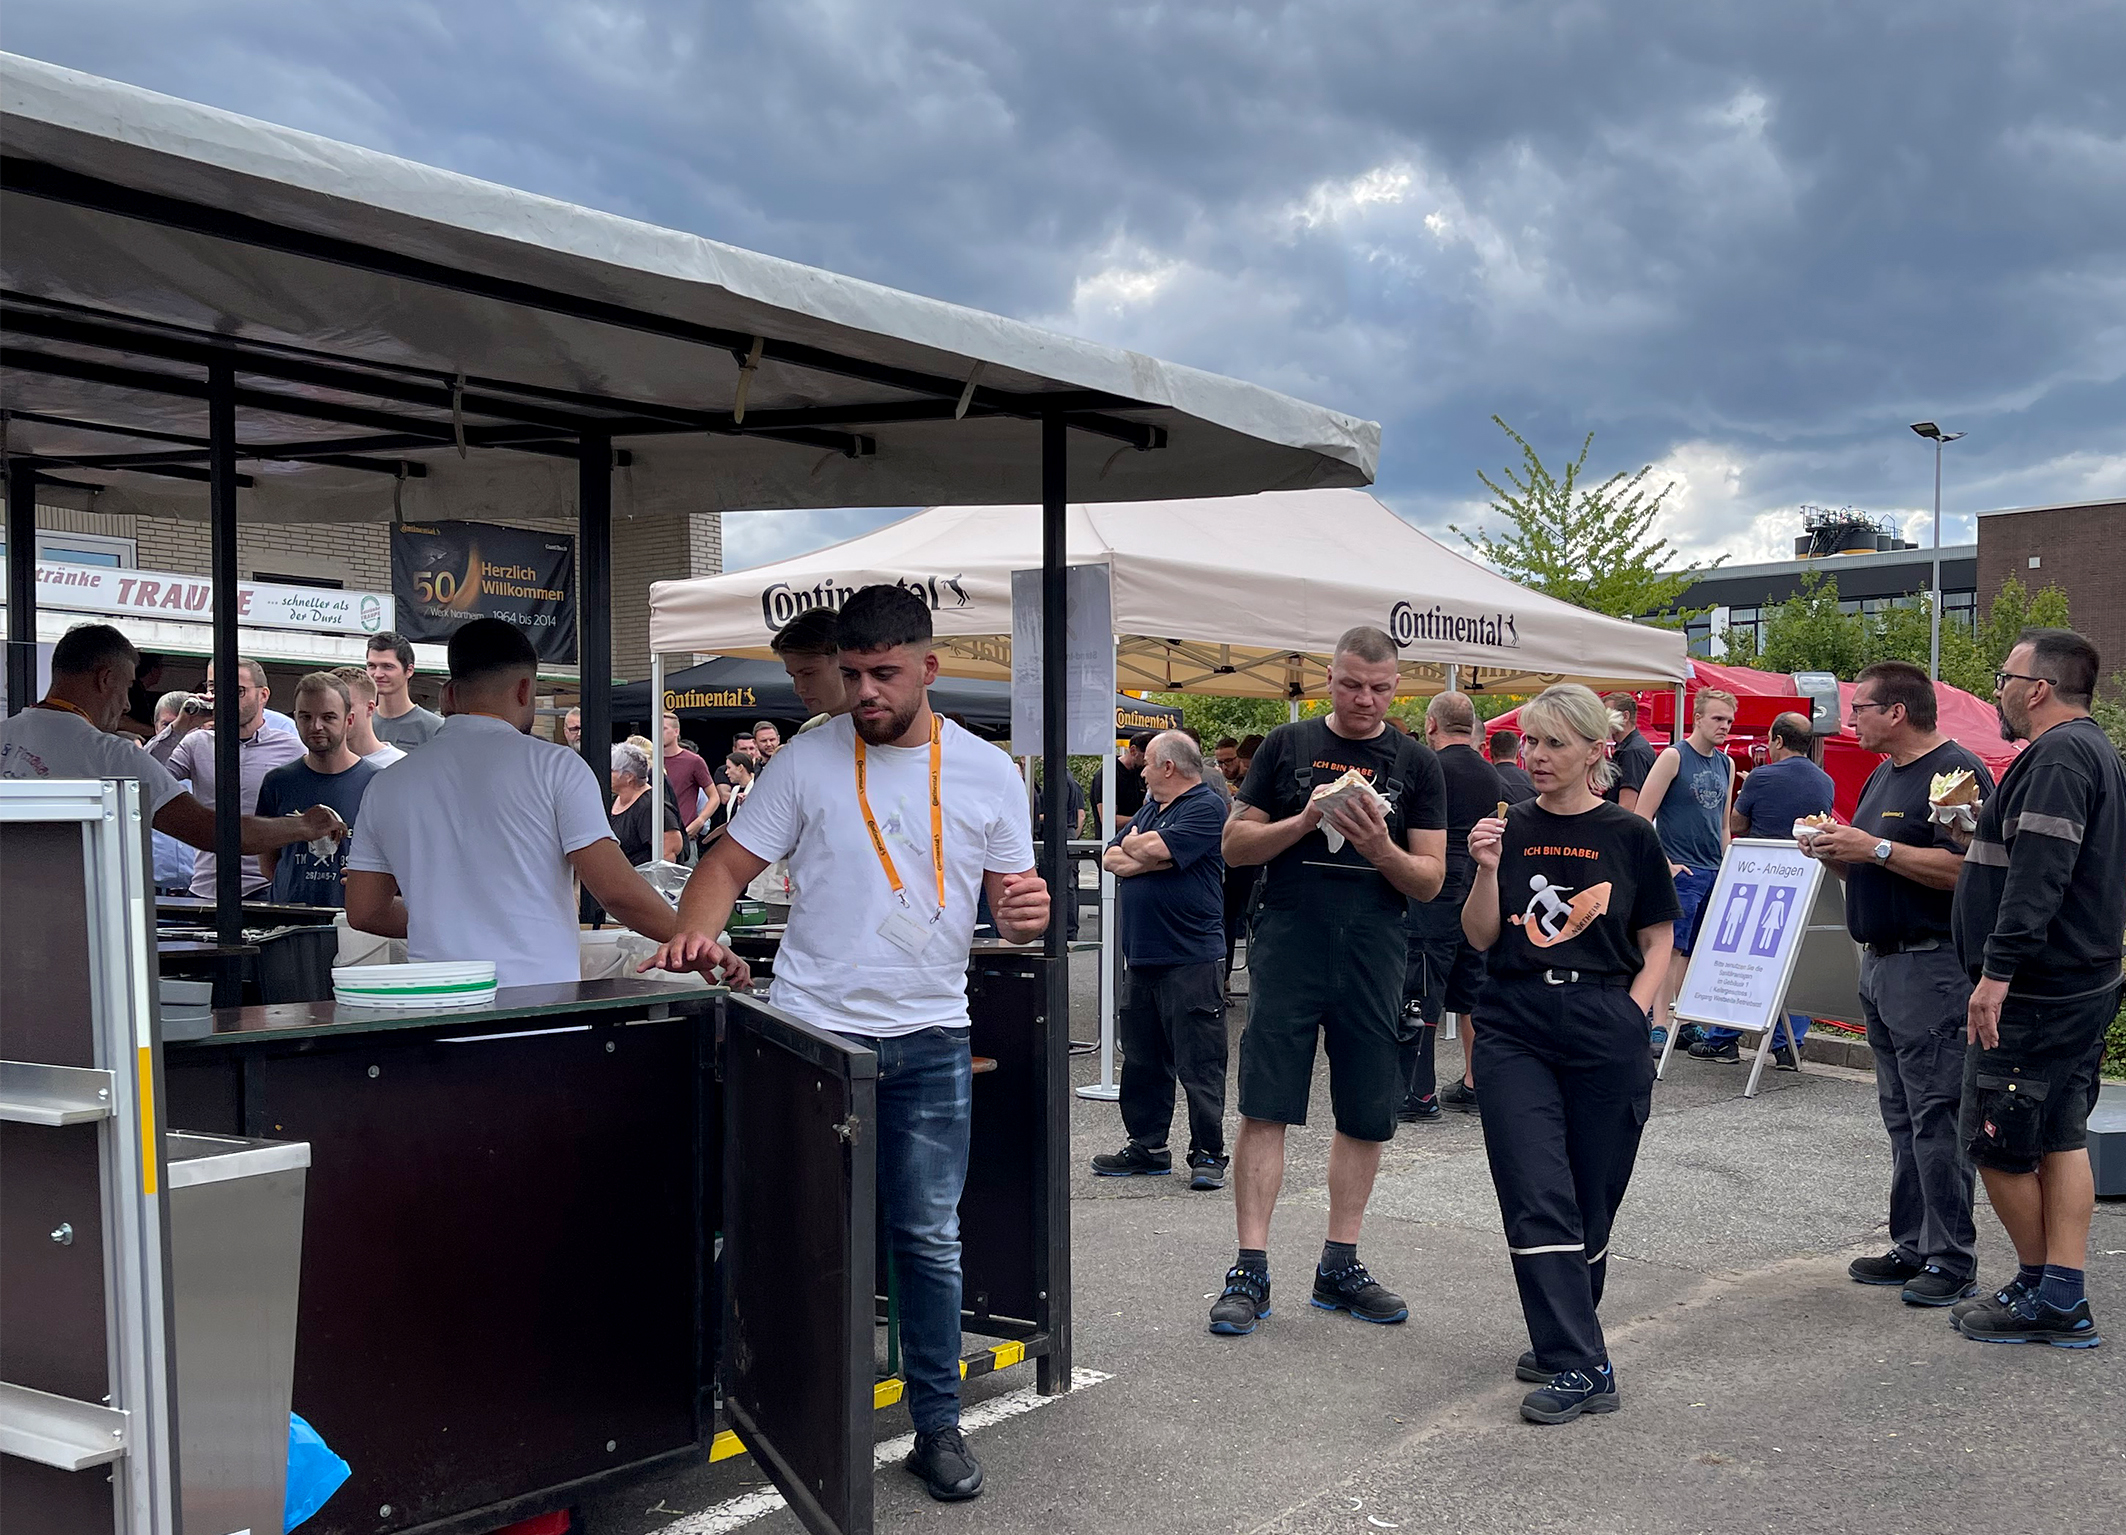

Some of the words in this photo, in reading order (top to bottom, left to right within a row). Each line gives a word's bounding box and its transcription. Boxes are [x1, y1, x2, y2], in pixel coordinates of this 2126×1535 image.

[36, 567, 101, 588] tränke
[482, 562, 536, 581] Herzlich
[117, 578, 254, 616] TRAUE
[413, 571, 456, 604] 50
[482, 580, 564, 601] Willkommen
[281, 594, 330, 609] schneller
[333, 600, 349, 611] als
[290, 609, 307, 621] der
[310, 609, 342, 624] Durst
[493, 611, 516, 623] 1964
[519, 613, 532, 625] bis
[533, 614, 557, 627] 2014
[1390, 601, 1503, 648] Continental
[664, 688, 742, 713] Continental
[1116, 708, 1168, 729] Continental
[1312, 760, 1329, 769] ICH
[1331, 763, 1347, 772] BIN
[1524, 846, 1541, 857] ICH
[1543, 846, 1561, 856] BIN
[1563, 847, 1599, 860] DABEI!
[1737, 861, 1755, 873] WC
[1762, 863, 1804, 878] Anlagen
[1571, 902, 1602, 935] NORTHEIM
